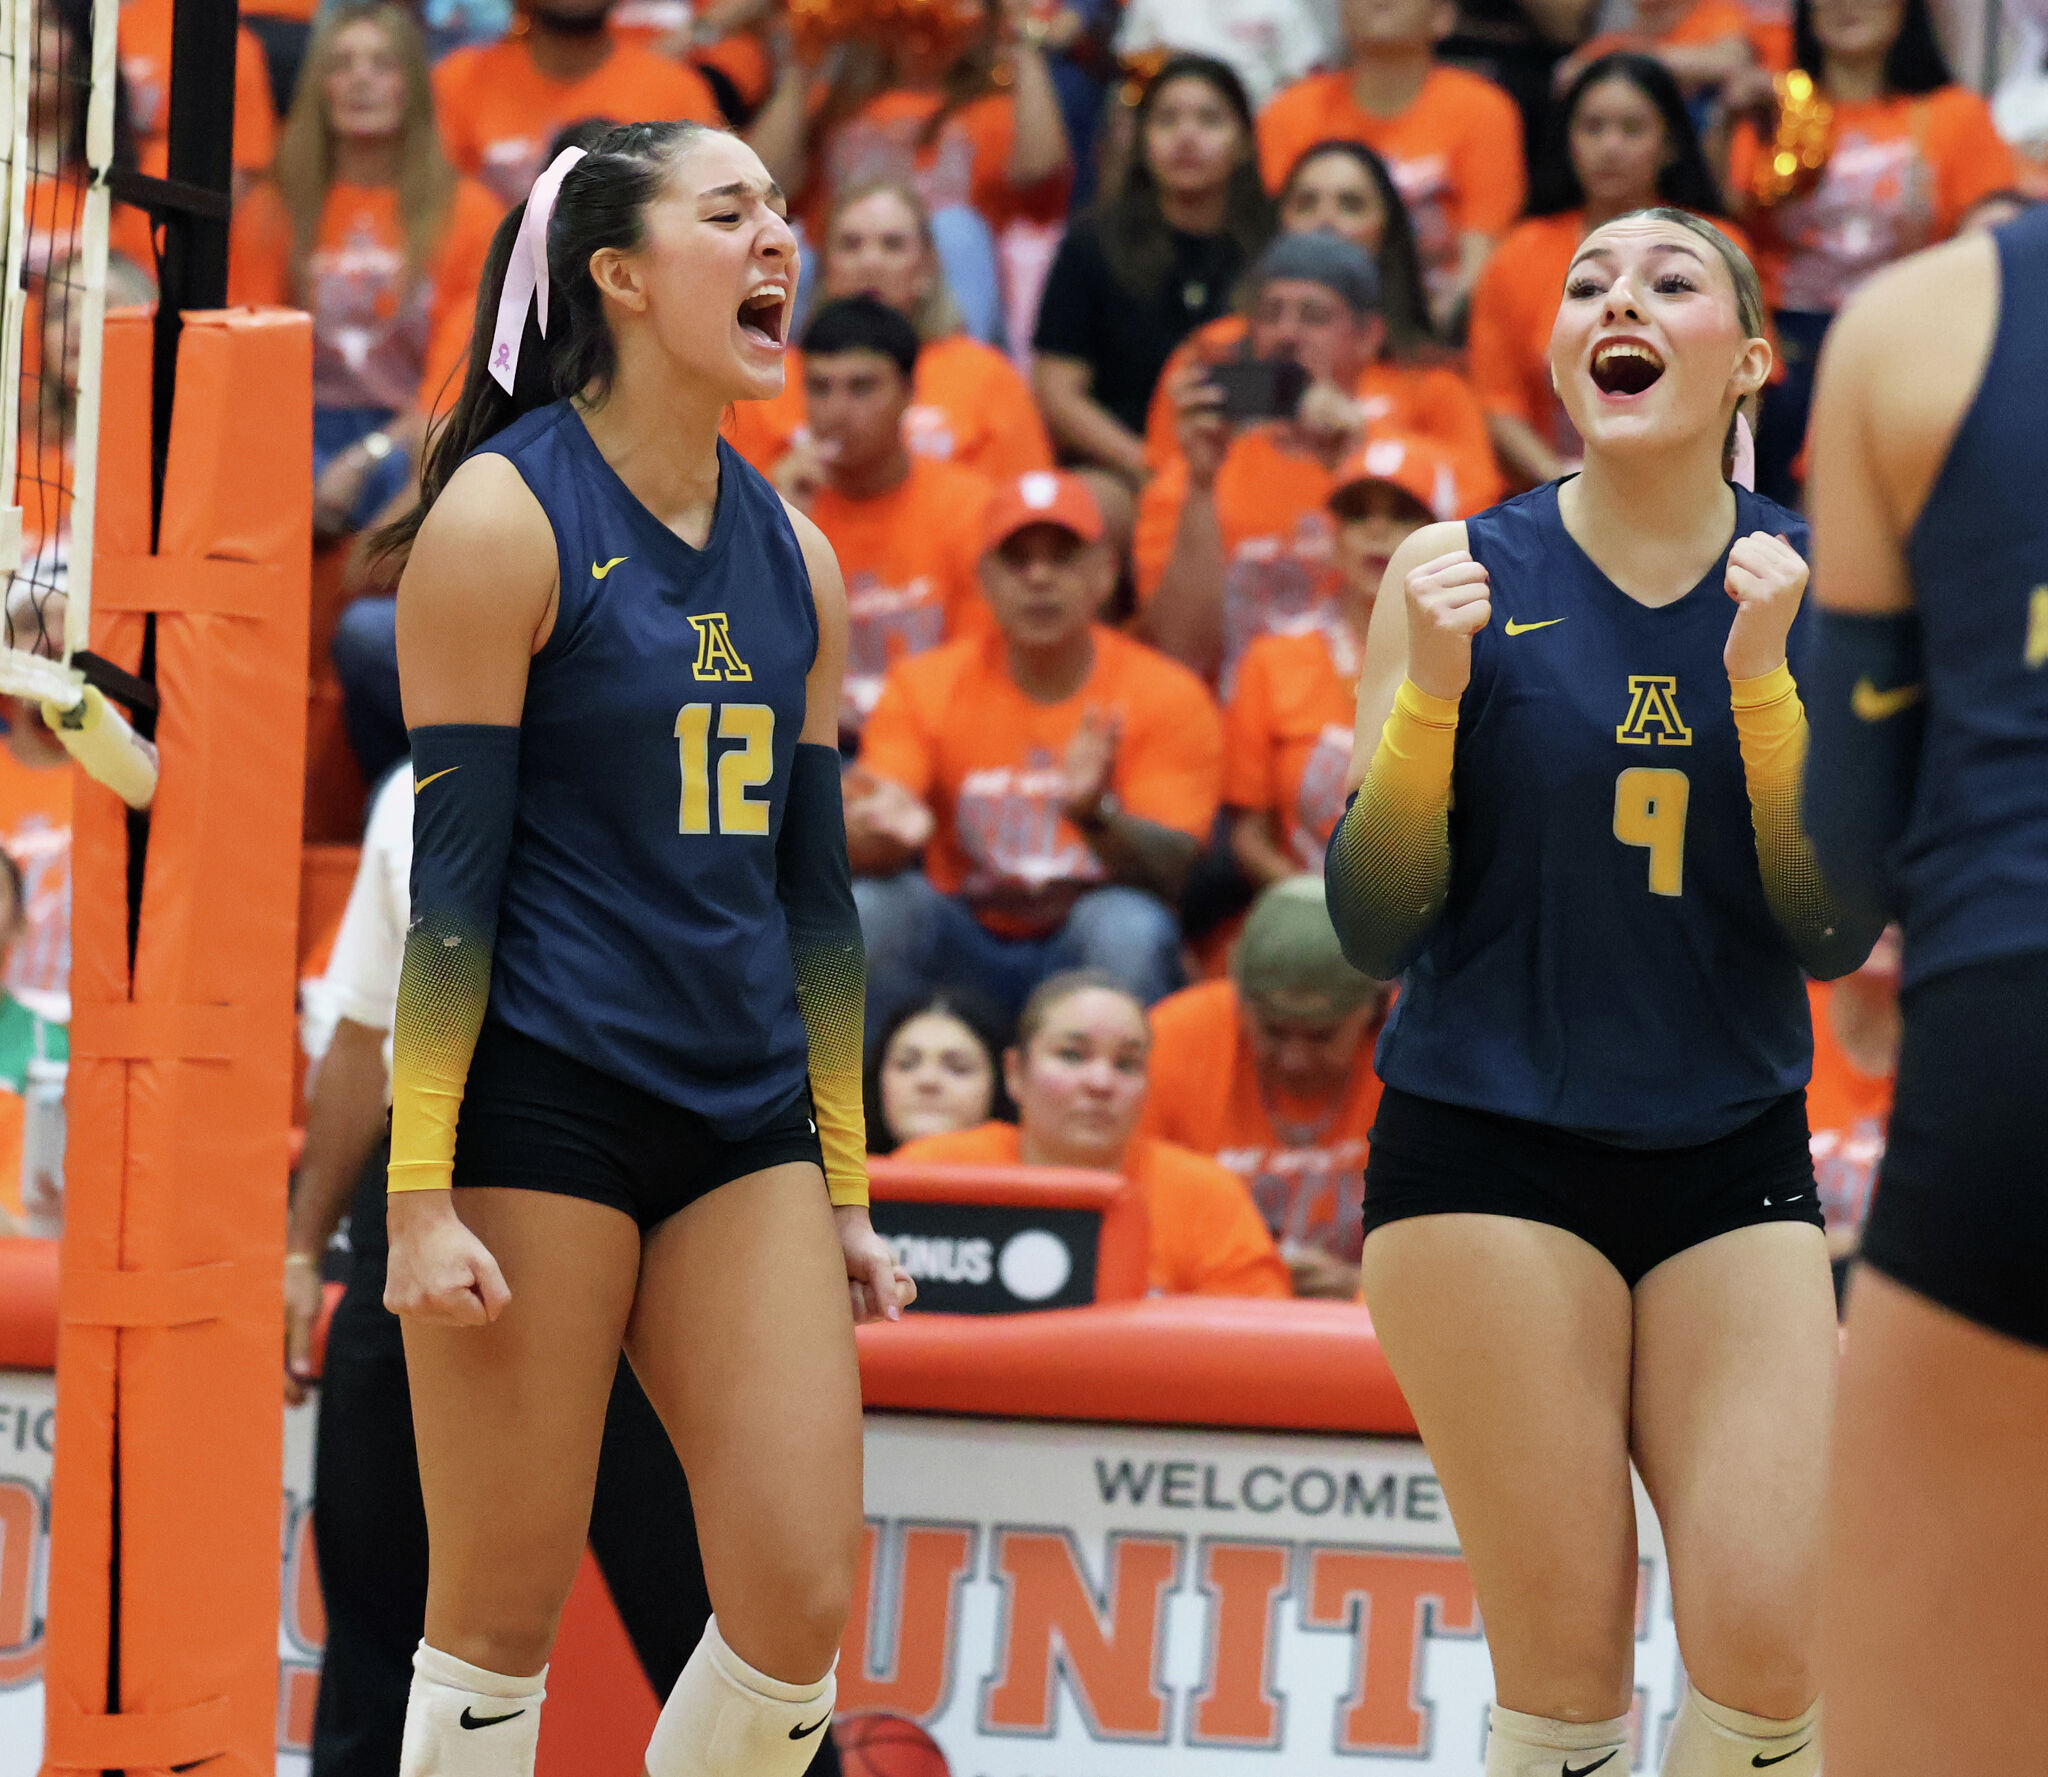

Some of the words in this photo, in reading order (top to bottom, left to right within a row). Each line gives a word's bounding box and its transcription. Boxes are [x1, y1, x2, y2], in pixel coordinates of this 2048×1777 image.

[687, 612, 752, 681] A
[1616, 675, 1692, 746] A
[674, 703, 775, 835] 12
[1613, 767, 1690, 896] 9
[877, 1235, 993, 1284] ONUS
[1095, 1459, 1441, 1521] WELCOME
